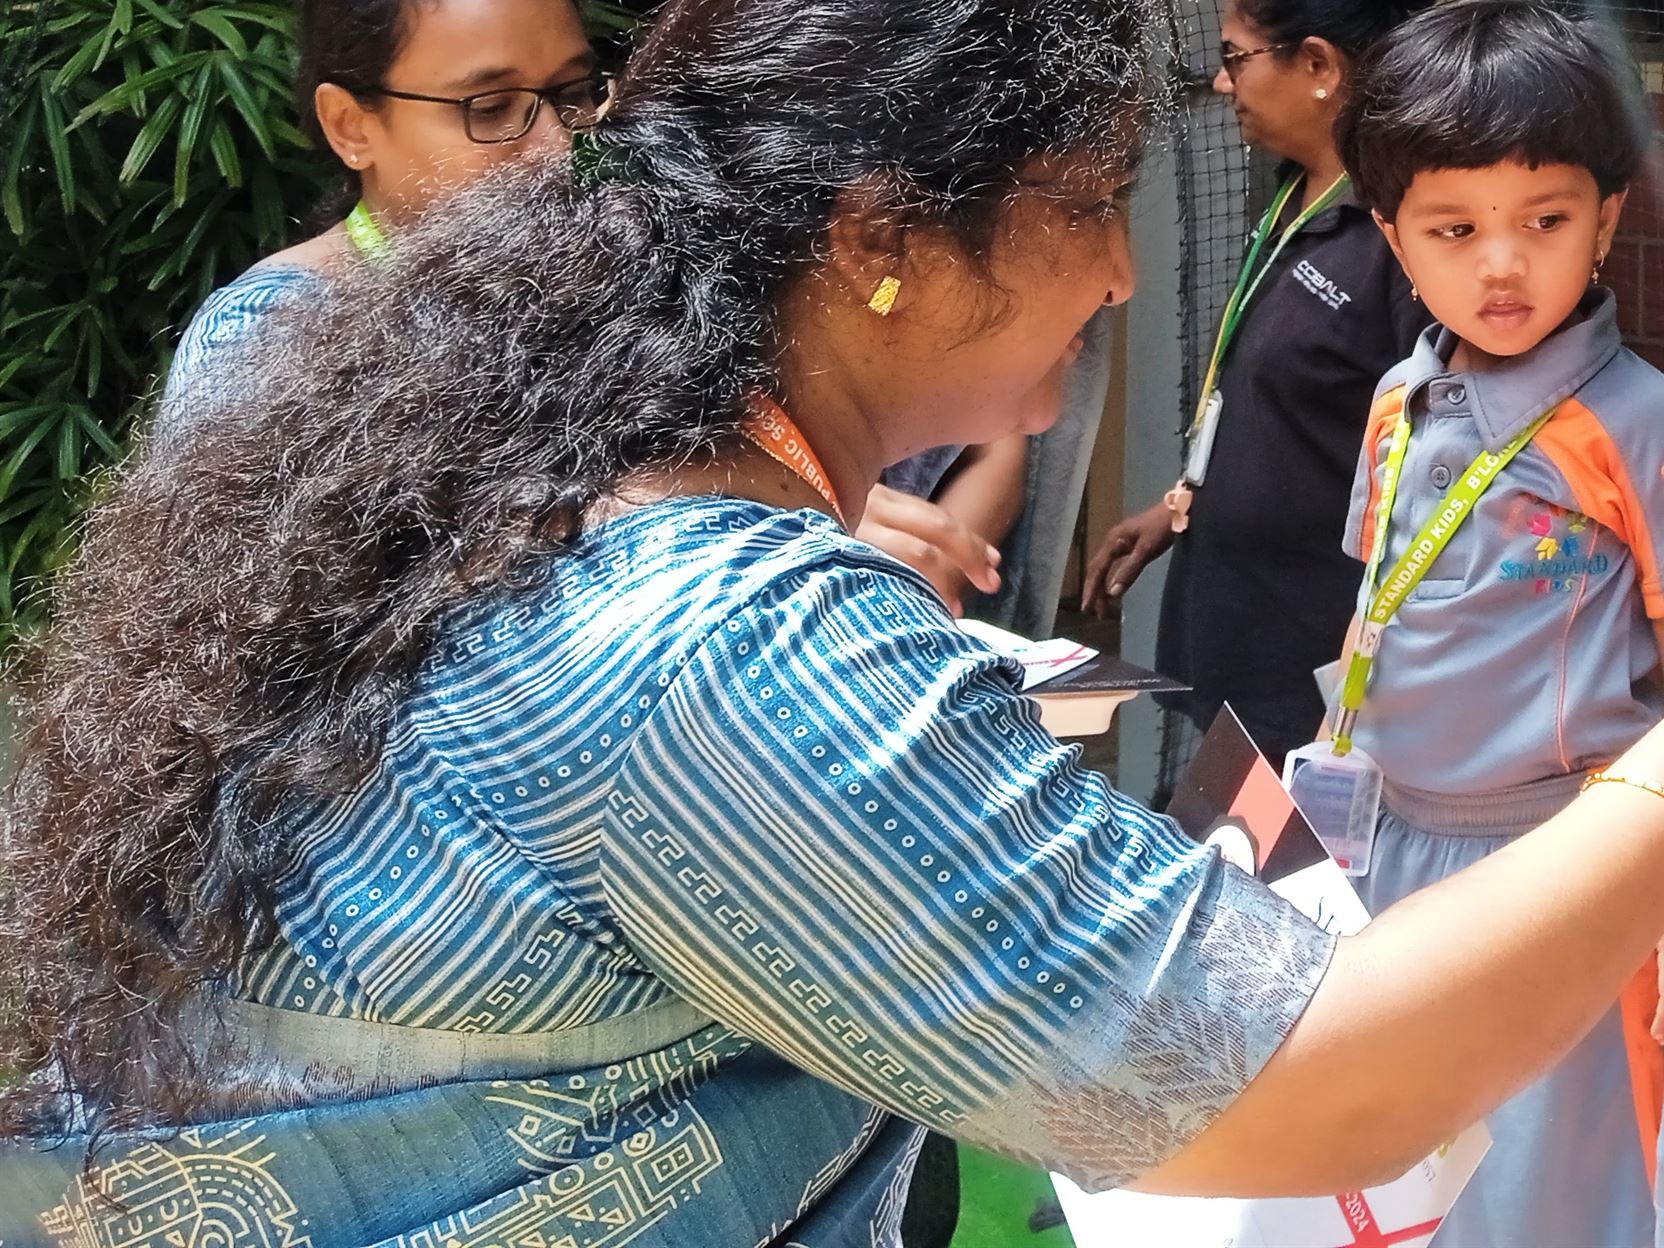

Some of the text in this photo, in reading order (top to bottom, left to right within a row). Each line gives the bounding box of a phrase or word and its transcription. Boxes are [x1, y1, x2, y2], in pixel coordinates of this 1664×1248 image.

[784, 439, 831, 502] PUBLIC
[1375, 538, 1434, 619] STANDARD
[1430, 497, 1470, 540] KIDS,
